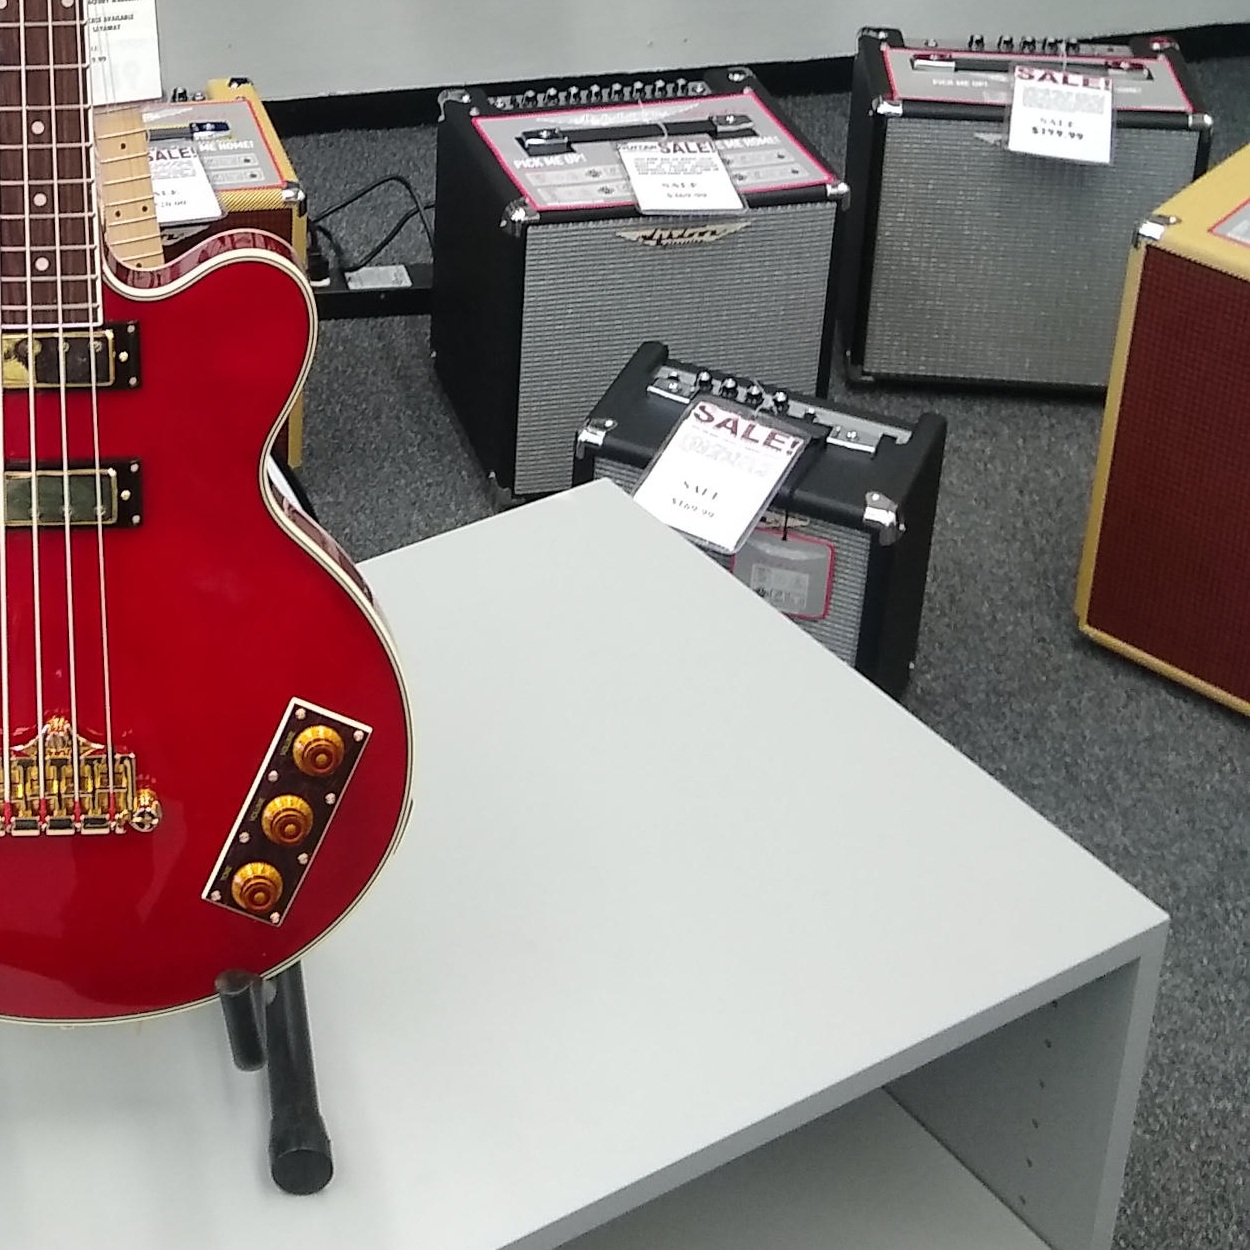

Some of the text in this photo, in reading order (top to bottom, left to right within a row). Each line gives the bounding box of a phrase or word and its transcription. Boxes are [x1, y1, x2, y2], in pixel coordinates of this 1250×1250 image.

[1015, 65, 1111, 91] SALE!
[219, 140, 254, 151] HOME!
[658, 142, 717, 154] SALE!
[513, 153, 587, 169] PICK ME UP!
[693, 405, 800, 456] SALE!
